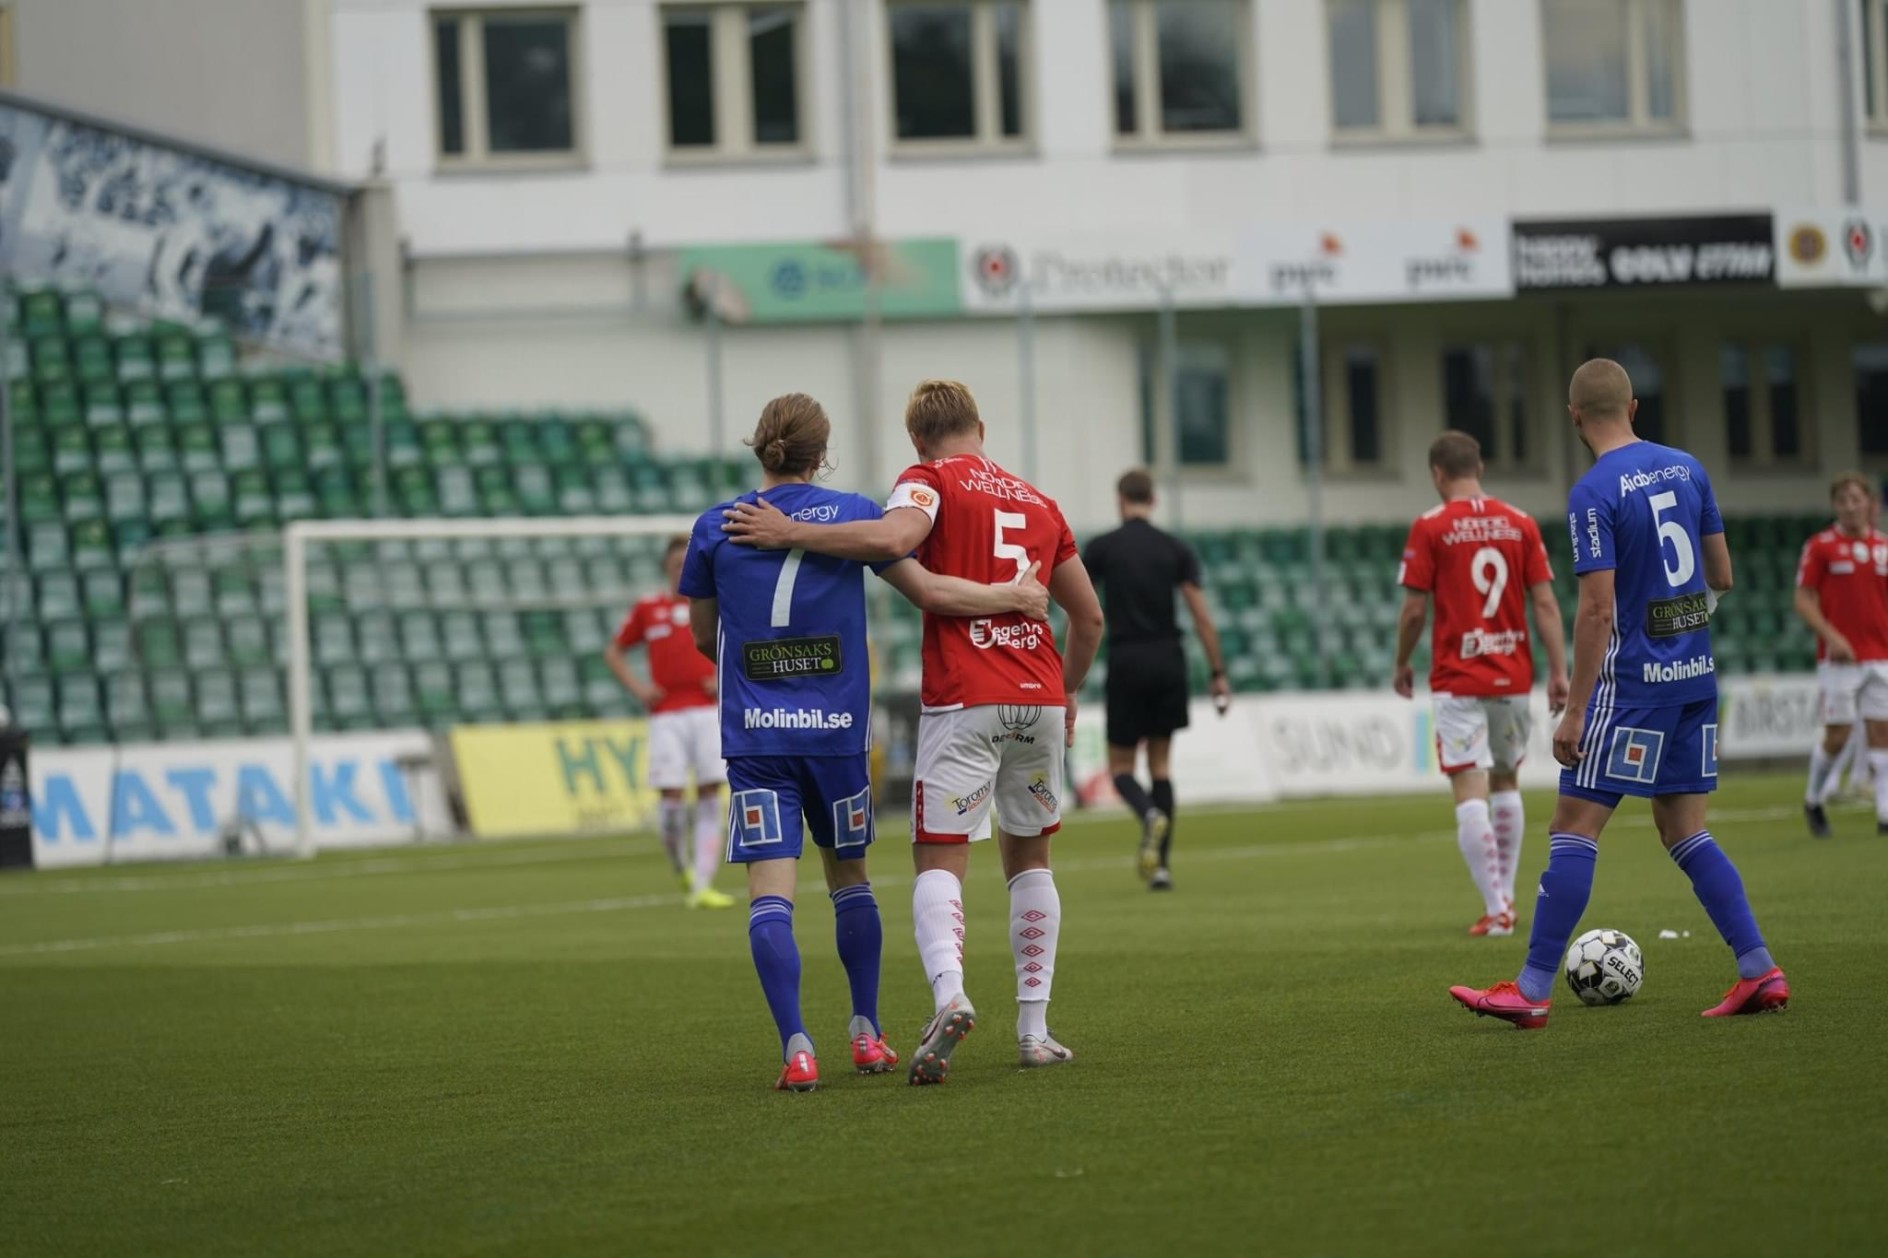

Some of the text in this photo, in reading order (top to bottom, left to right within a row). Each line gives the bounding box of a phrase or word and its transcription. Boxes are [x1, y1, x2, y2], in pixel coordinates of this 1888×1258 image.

[990, 507, 1031, 586] 5
[1586, 507, 1601, 559] stadium
[1648, 490, 1695, 588] 5
[1471, 546, 1509, 618] 9
[1672, 611, 1705, 630] HUSET
[749, 643, 832, 662] GRÖNSAKS
[773, 657, 822, 673] HUSET
[1643, 655, 1715, 683] Molinbil.s
[744, 707, 853, 729] Molinbil.se
[556, 736, 645, 798] HY
[31, 763, 416, 843] MATAKI
[1607, 956, 1639, 987] SELECT
